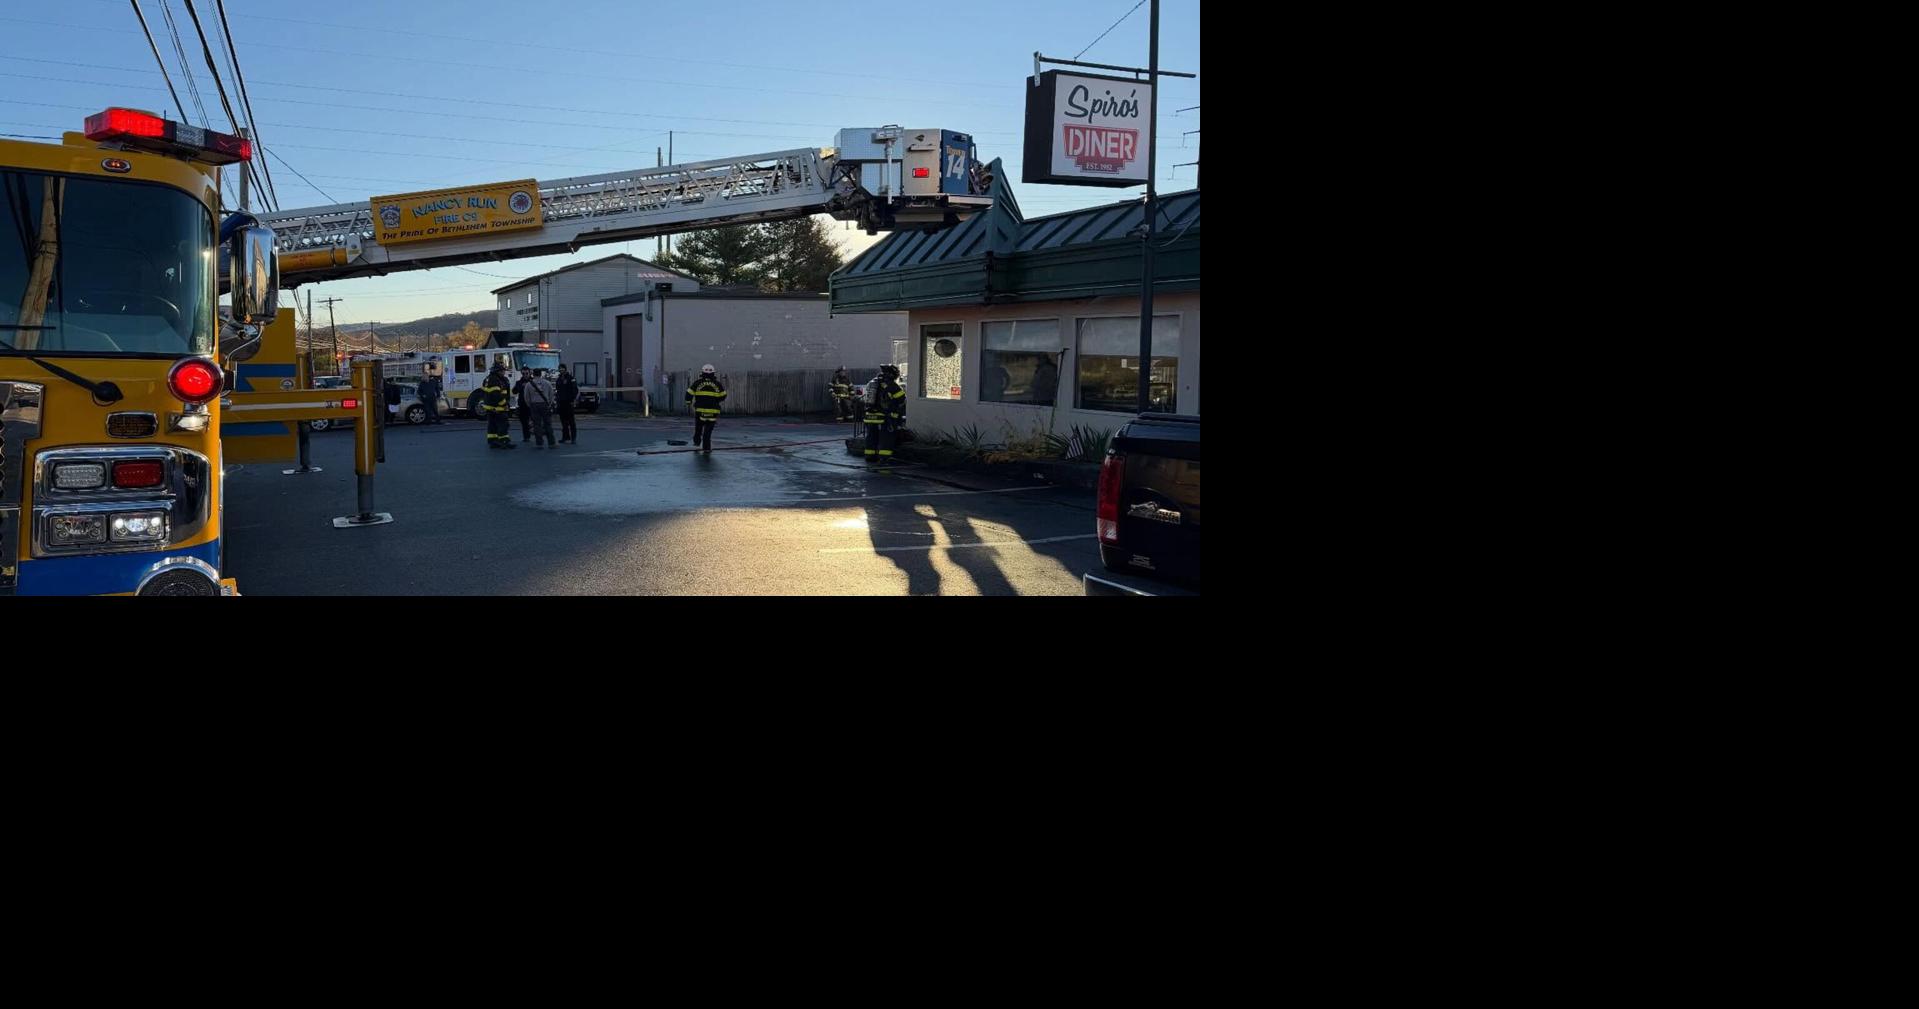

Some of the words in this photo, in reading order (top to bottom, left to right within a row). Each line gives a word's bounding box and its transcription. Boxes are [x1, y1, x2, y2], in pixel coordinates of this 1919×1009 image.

[1064, 85, 1139, 124] Spiro's
[1068, 128, 1133, 160] DINER
[946, 151, 965, 179] 14
[412, 197, 464, 218] NANCY
[467, 196, 497, 209] RUN
[434, 213, 460, 225] FIRE
